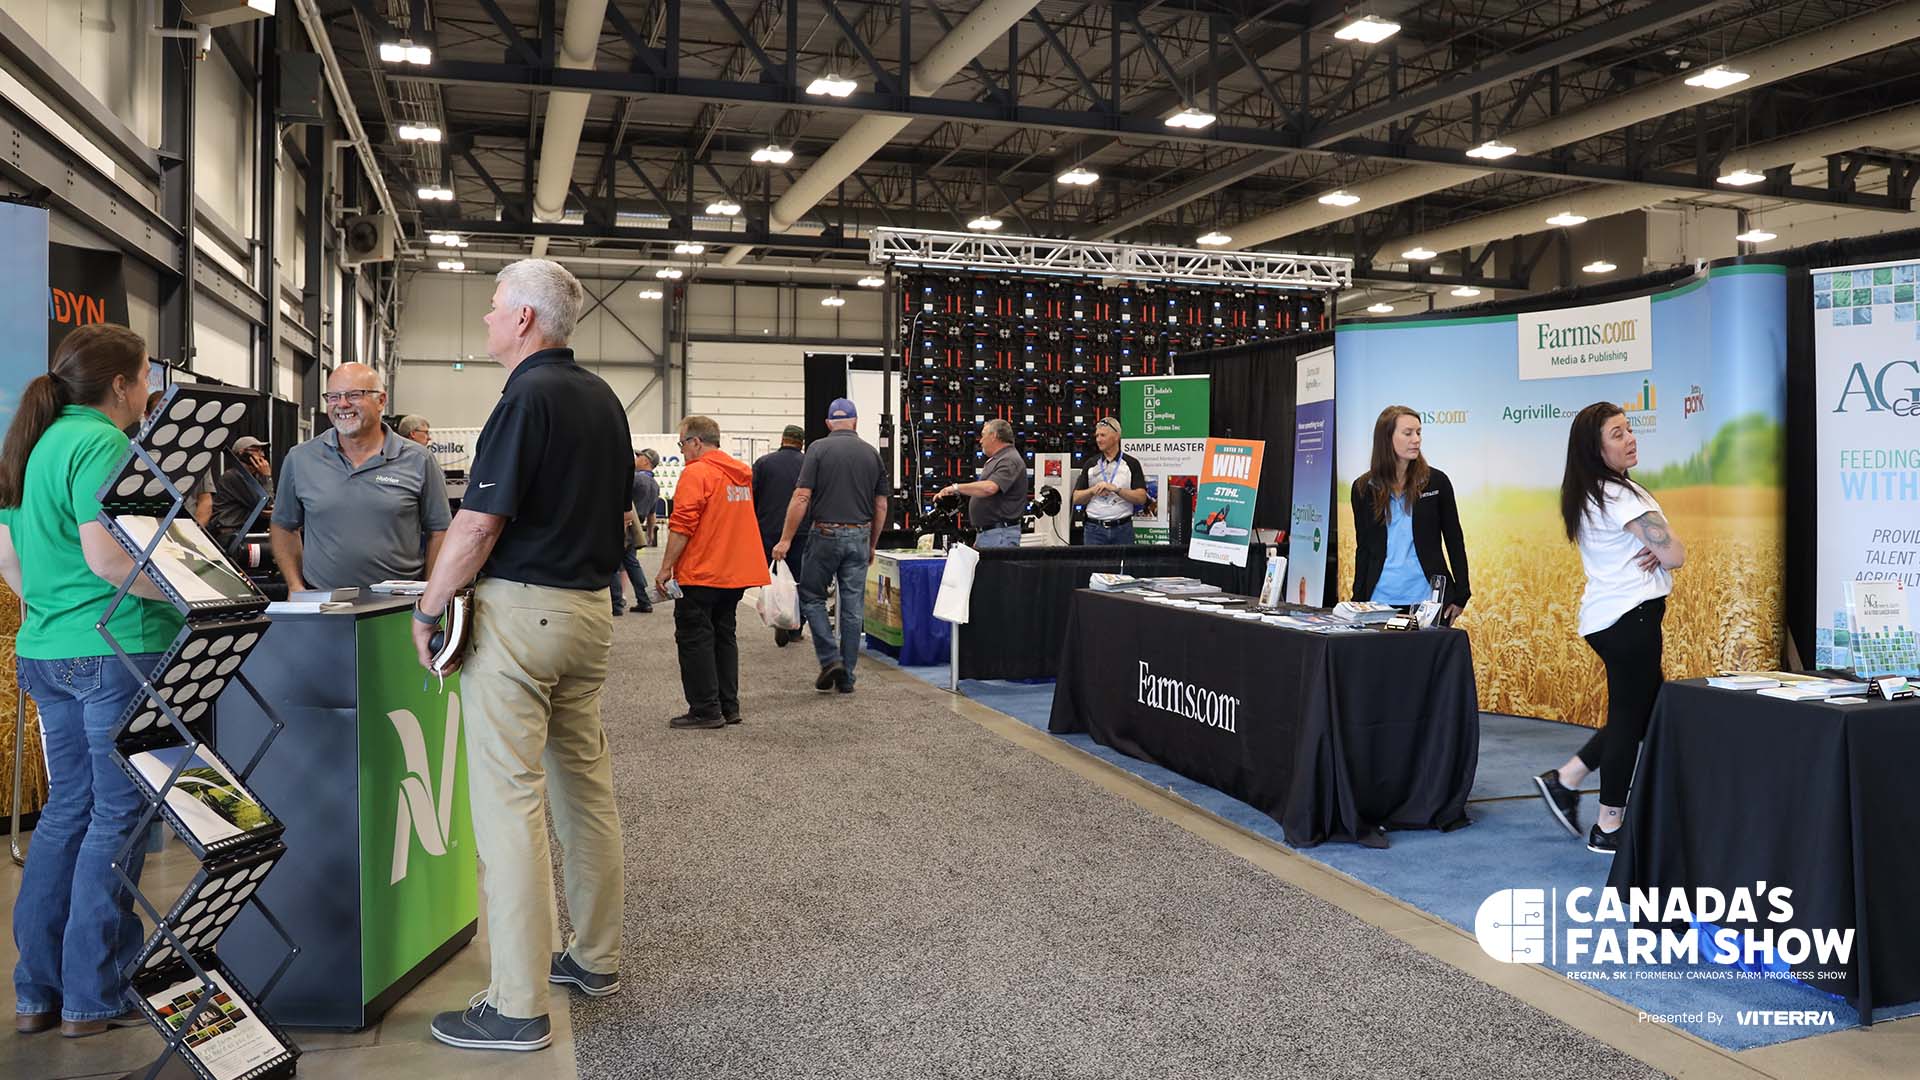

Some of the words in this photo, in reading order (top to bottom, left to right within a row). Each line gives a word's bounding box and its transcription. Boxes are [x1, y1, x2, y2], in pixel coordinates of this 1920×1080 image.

[50, 286, 105, 326] DYN
[1537, 319, 1636, 350] Farms.com
[1551, 354, 1578, 366] Media
[1580, 354, 1586, 363] &
[1588, 351, 1628, 362] Publishing
[1503, 404, 1578, 423] Agriville.com
[1124, 443, 1161, 452] SAMPLE
[1164, 443, 1204, 452] MASTER
[1212, 454, 1252, 480] WIN!
[1840, 450, 1920, 469] FEEDING
[1214, 487, 1240, 497] STIHL
[1840, 472, 1919, 500] WITH
[1866, 550, 1916, 565] TALENT
[1138, 660, 1236, 733] Farms.com
